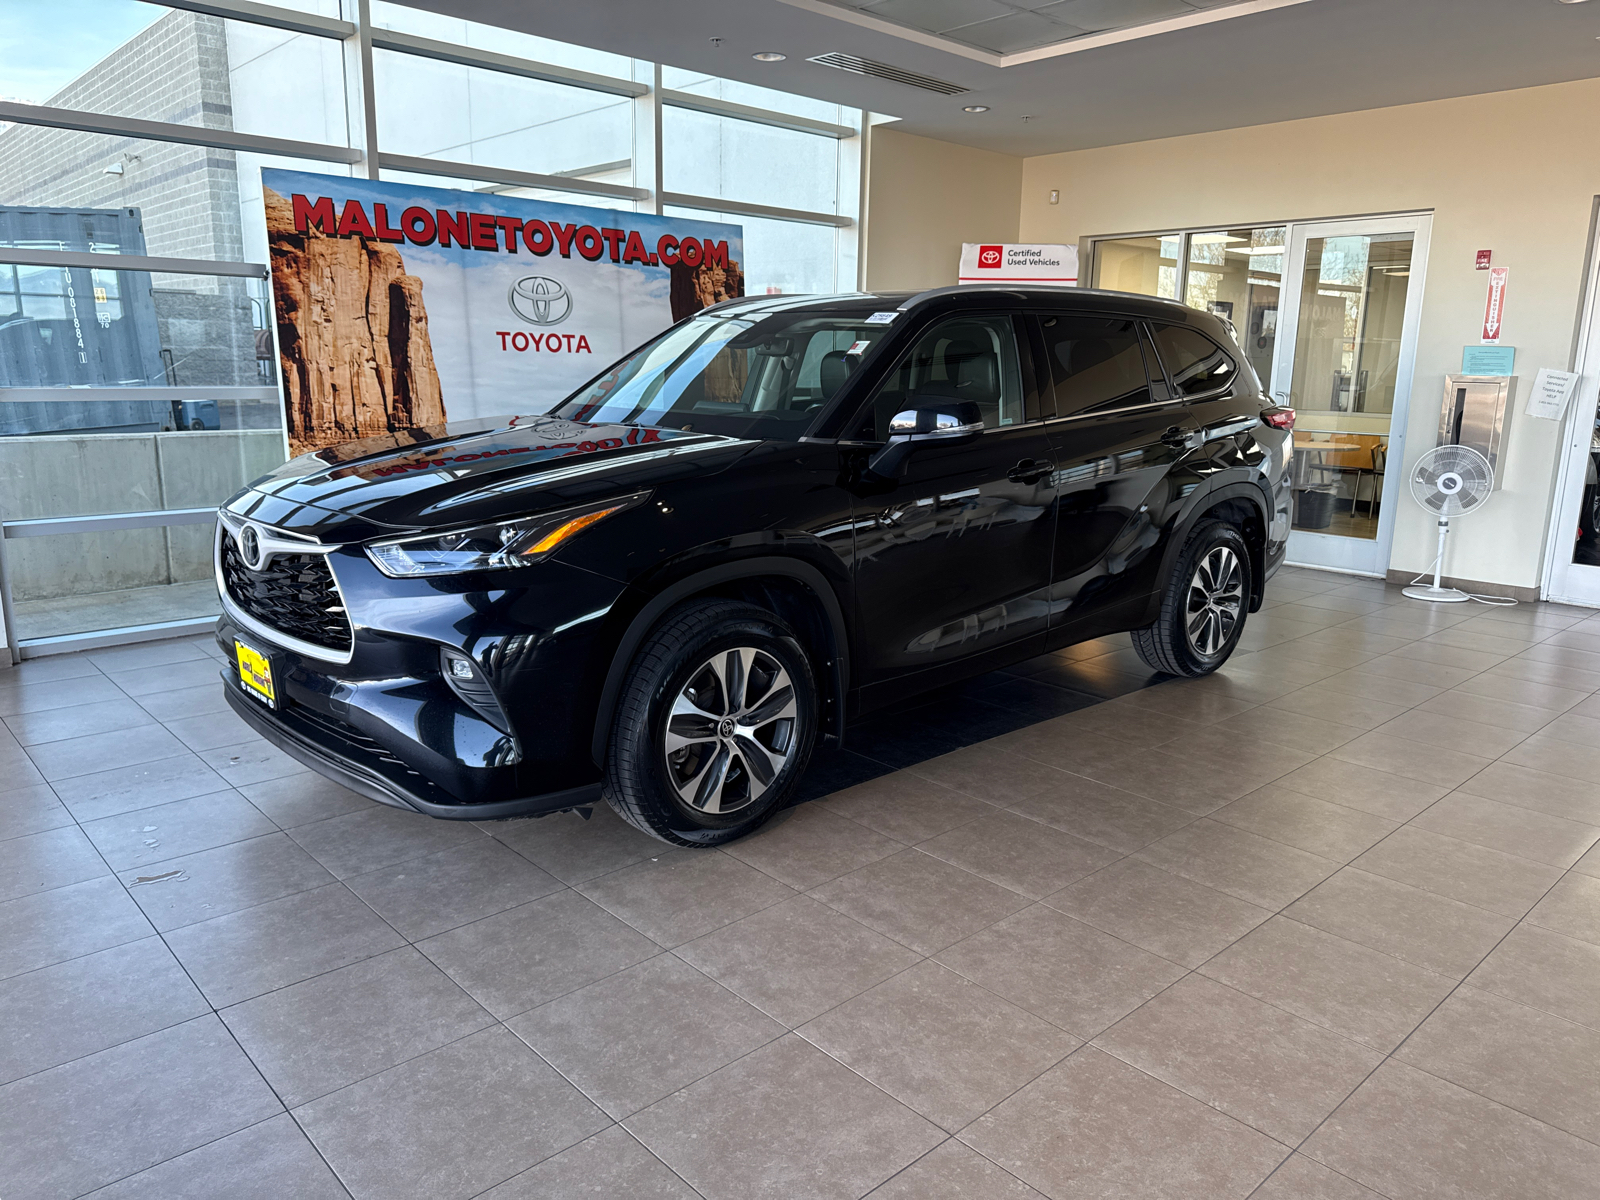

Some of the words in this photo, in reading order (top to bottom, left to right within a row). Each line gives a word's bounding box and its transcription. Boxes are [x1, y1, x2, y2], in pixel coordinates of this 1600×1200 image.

[291, 194, 729, 270] MALONETOYOTA.COM
[1008, 249, 1041, 257] Certified
[1007, 258, 1027, 266] Used
[1029, 258, 1060, 267] Vehicles
[496, 331, 593, 354] TOYOTA
